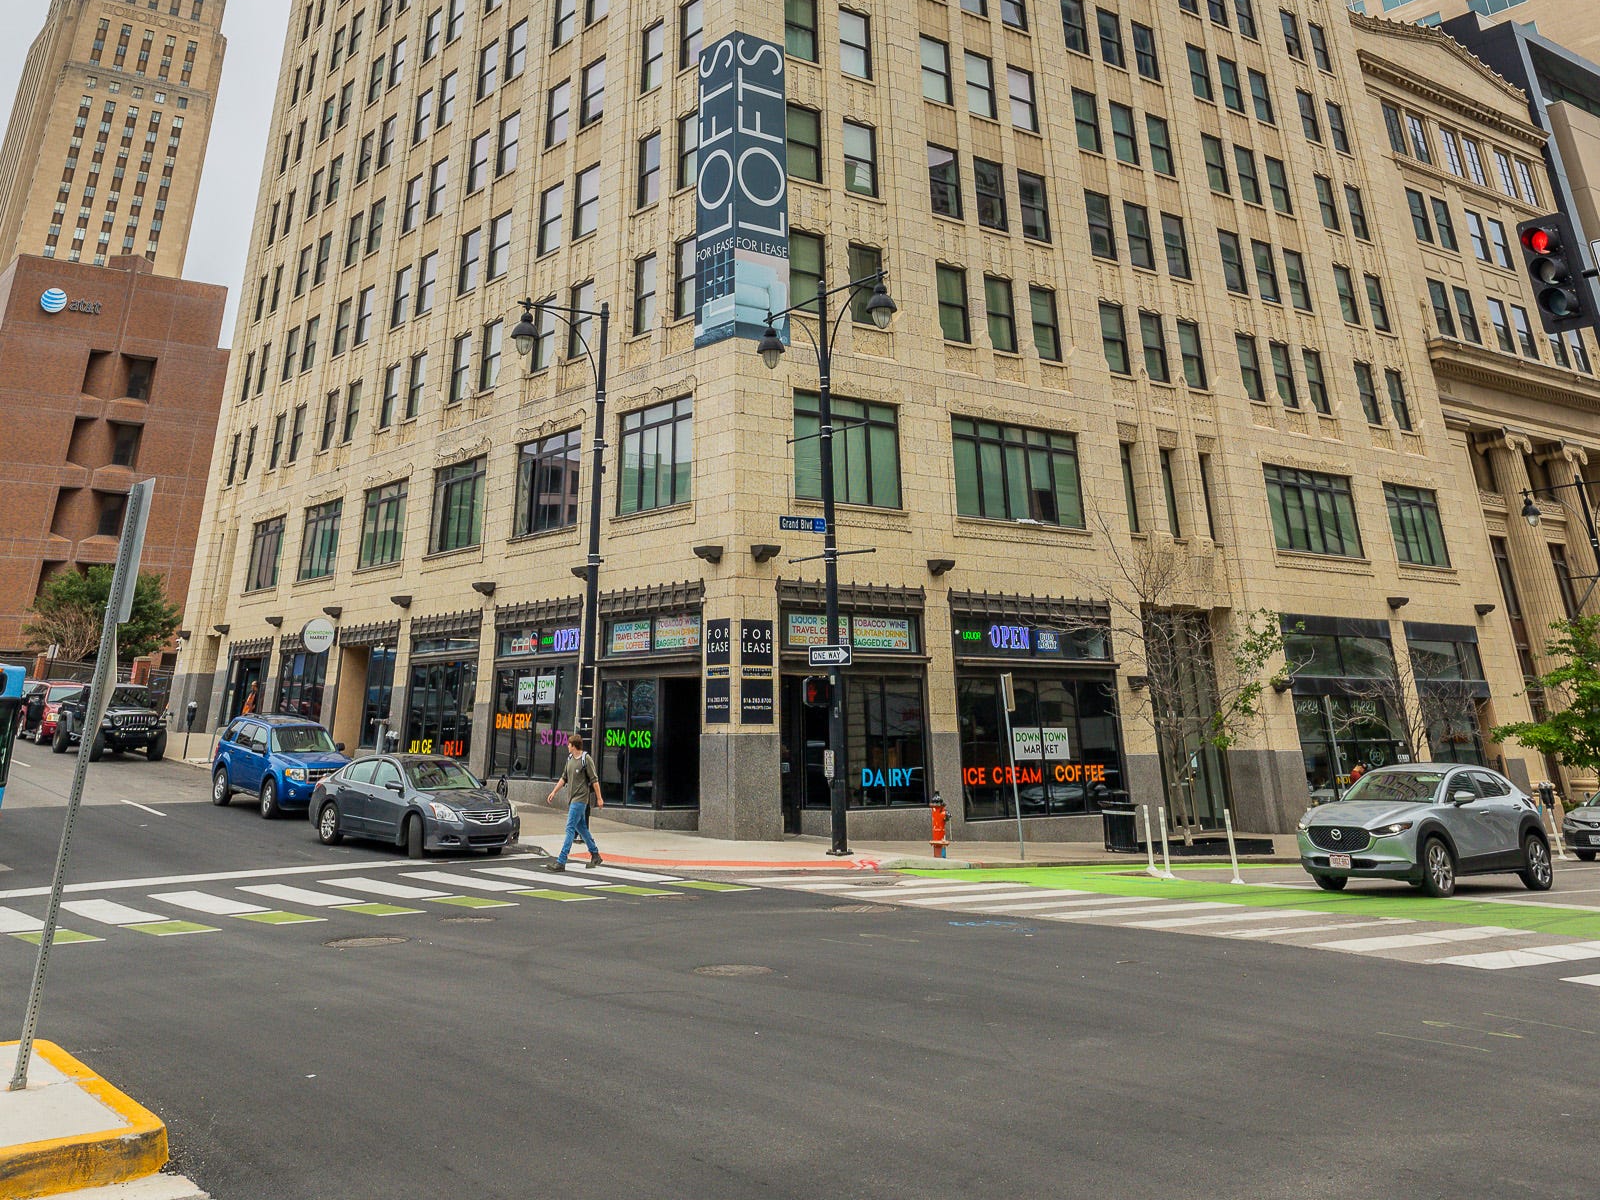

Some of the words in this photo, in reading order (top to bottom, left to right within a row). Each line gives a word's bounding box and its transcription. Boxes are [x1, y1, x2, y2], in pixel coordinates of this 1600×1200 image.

[698, 39, 733, 241] LOFTS
[737, 39, 785, 237] LOFTS
[697, 247, 721, 262] FOR
[713, 237, 734, 255] LEASE
[736, 237, 758, 252] FOR
[760, 242, 787, 258] LEASE
[69, 298, 102, 315] at&t
[782, 518, 799, 529] Grand
[800, 519, 813, 530] Blvd
[658, 618, 683, 628] TOBACCO
[685, 617, 699, 625] WINE
[791, 616, 818, 624] LIQUOR
[854, 619, 886, 628] TOBACCO
[889, 621, 906, 629] WINE
[615, 624, 633, 633] LIQUOR
[707, 627, 729, 640] FOR
[742, 628, 771, 640] FOR
[792, 625, 818, 634] TRAVEL
[885, 630, 907, 638] DRINKS
[615, 632, 633, 641] TRAVEL
[633, 630, 650, 640] CENTE
[790, 635, 807, 643] BEER
[962, 631, 981, 640] LIQUOR
[991, 625, 1030, 649] OPEN
[625, 640, 644, 649] COFFEE
[656, 638, 677, 647] BAGGED
[678, 637, 687, 645] ICE
[688, 637, 699, 645] ATM
[707, 641, 729, 653] LEASE
[742, 642, 771, 653] LEASE
[854, 638, 880, 647] BAGGED
[881, 639, 892, 647] ICE
[813, 651, 826, 660] ONE
[828, 651, 841, 659] WAY
[495, 713, 532, 729] BAKERY
[541, 729, 568, 746] SODA
[605, 729, 651, 749] SNACKS
[408, 739, 433, 754] JUICE
[443, 740, 463, 756] DELI
[1023, 744, 1059, 754] MARKET
[861, 767, 913, 787] DAIRY
[963, 767, 987, 785] ICE
[992, 765, 1043, 785] CREAM
[1054, 764, 1106, 783] COFFEE
